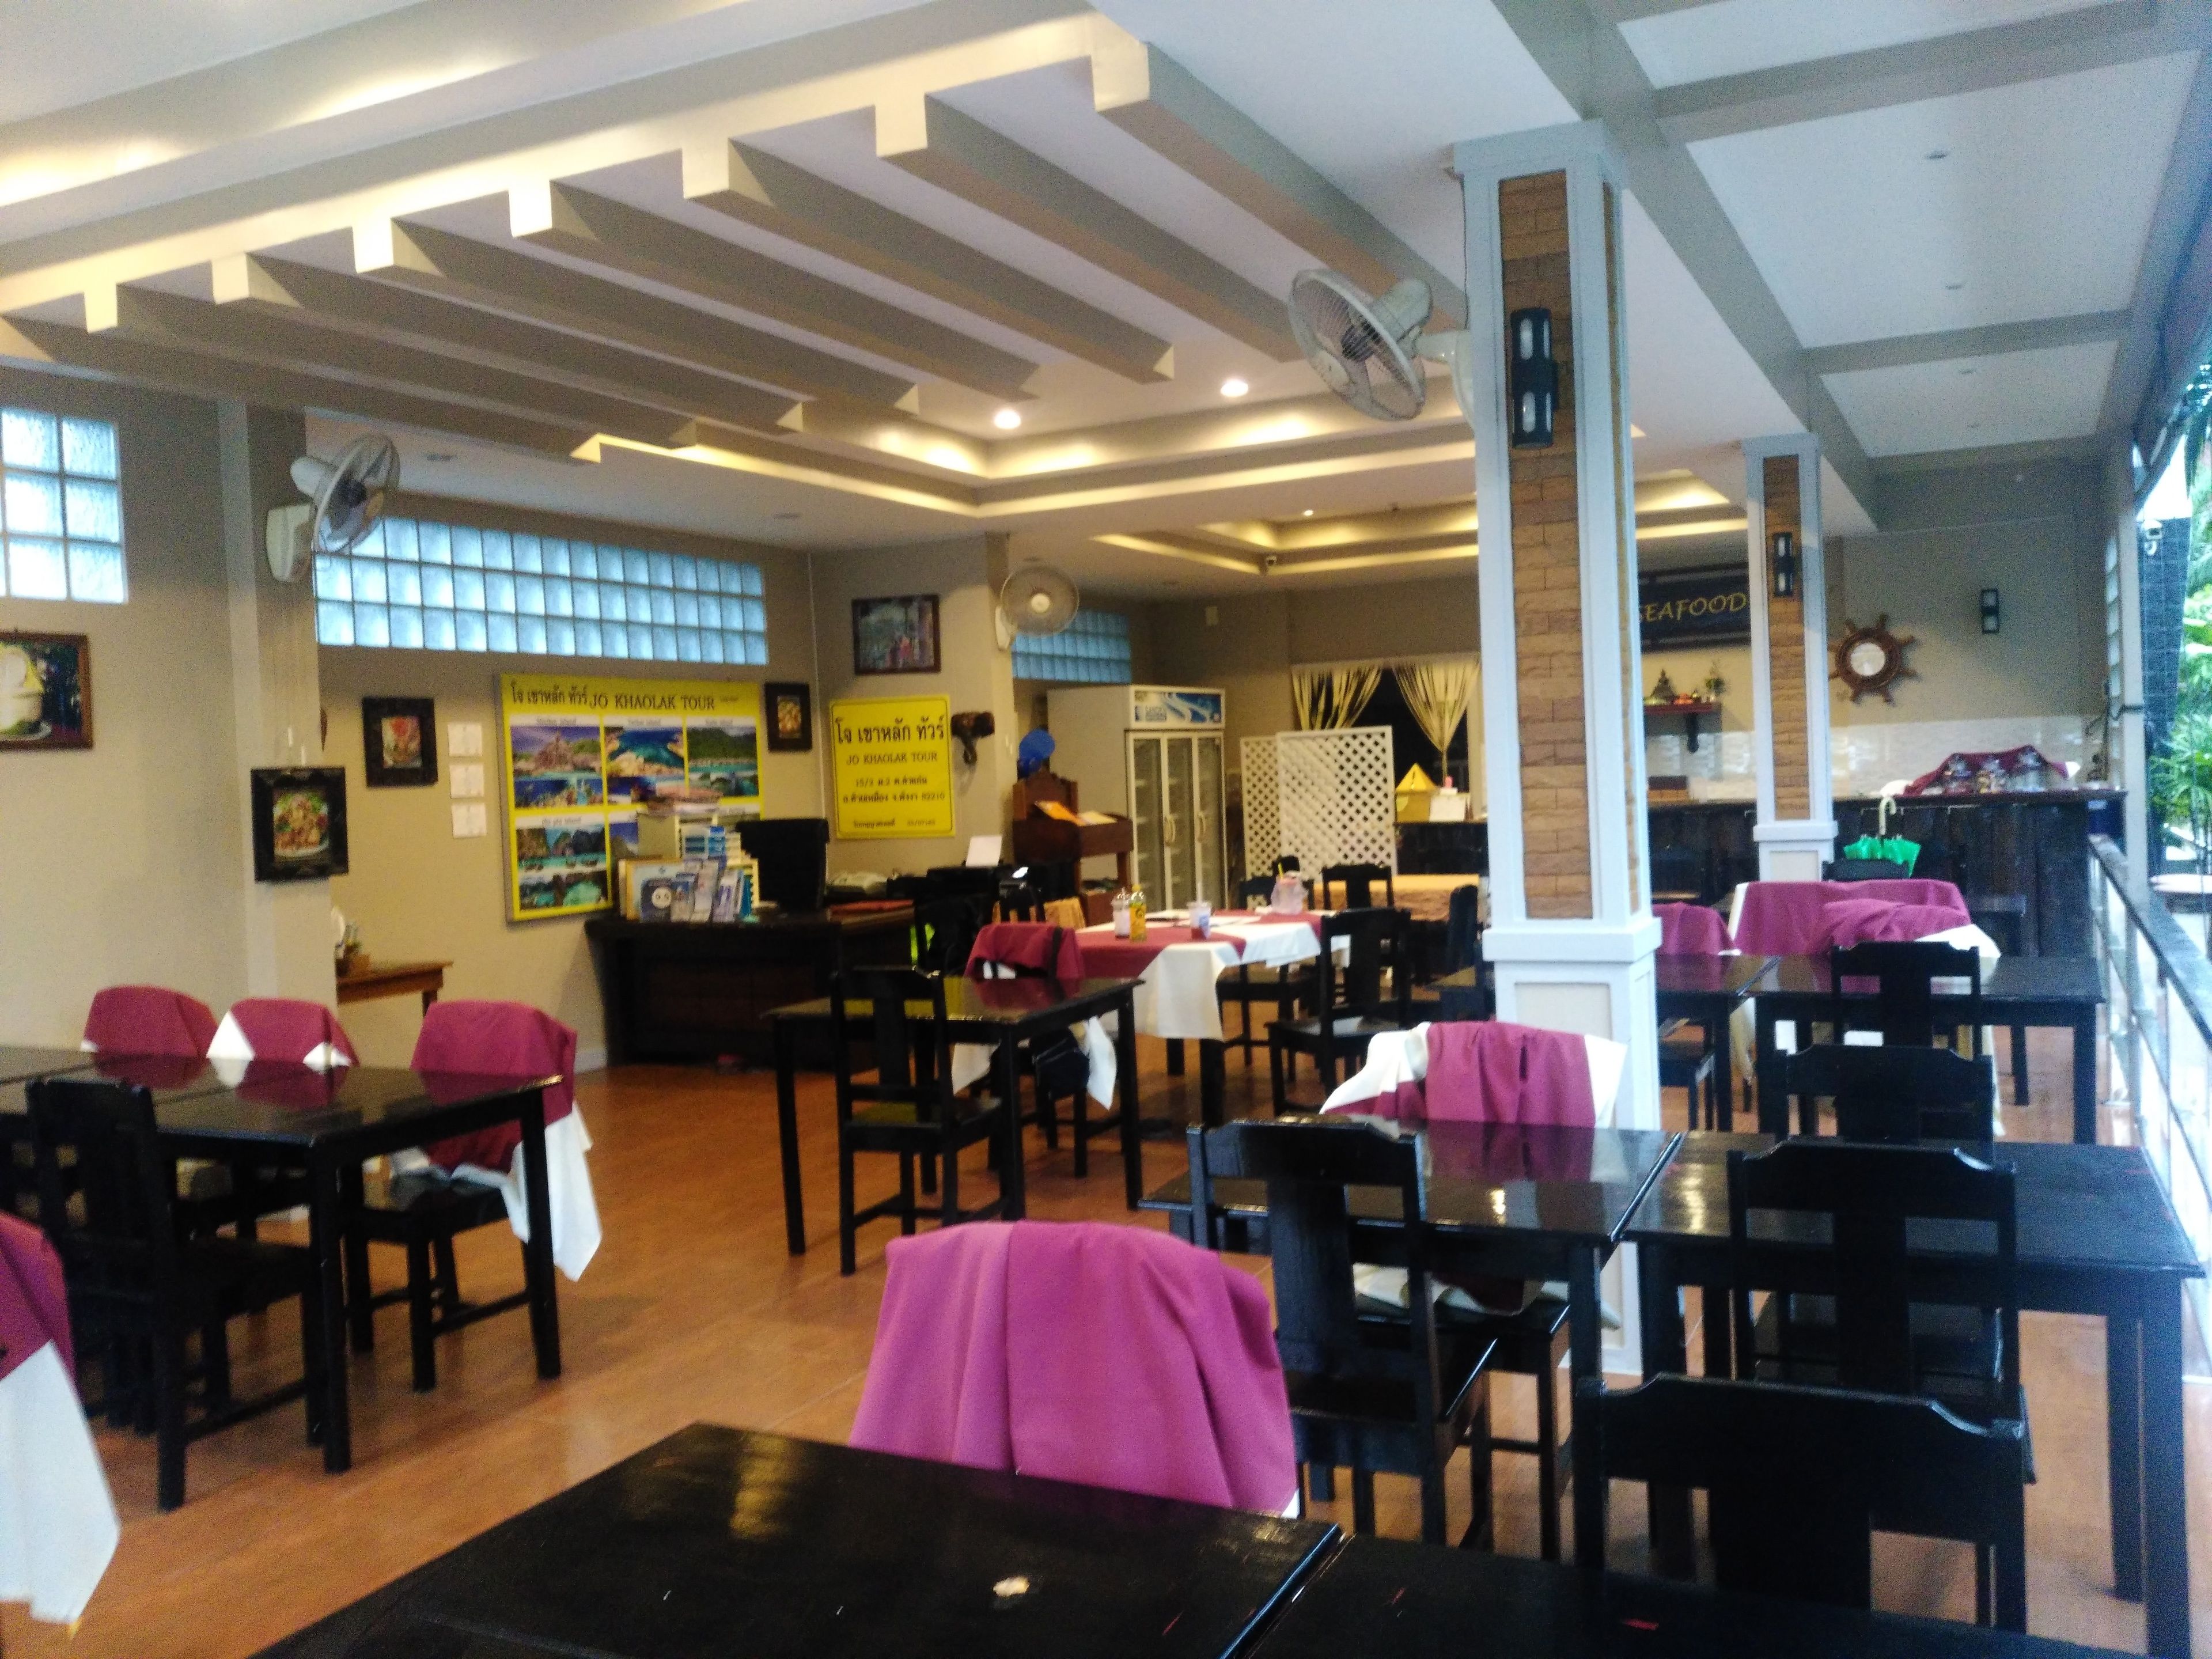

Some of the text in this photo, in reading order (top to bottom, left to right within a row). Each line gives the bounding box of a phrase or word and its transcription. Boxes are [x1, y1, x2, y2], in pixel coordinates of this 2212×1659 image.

[1641, 592, 1747, 622] EAFOOD
[589, 692, 608, 710] JO
[615, 692, 676, 710] KHAOLAK
[680, 695, 715, 711] TOUR
[835, 715, 944, 744] โจ เขาหลัก ทัวร์
[846, 751, 938, 765] JO KHAOLAK TOUR
